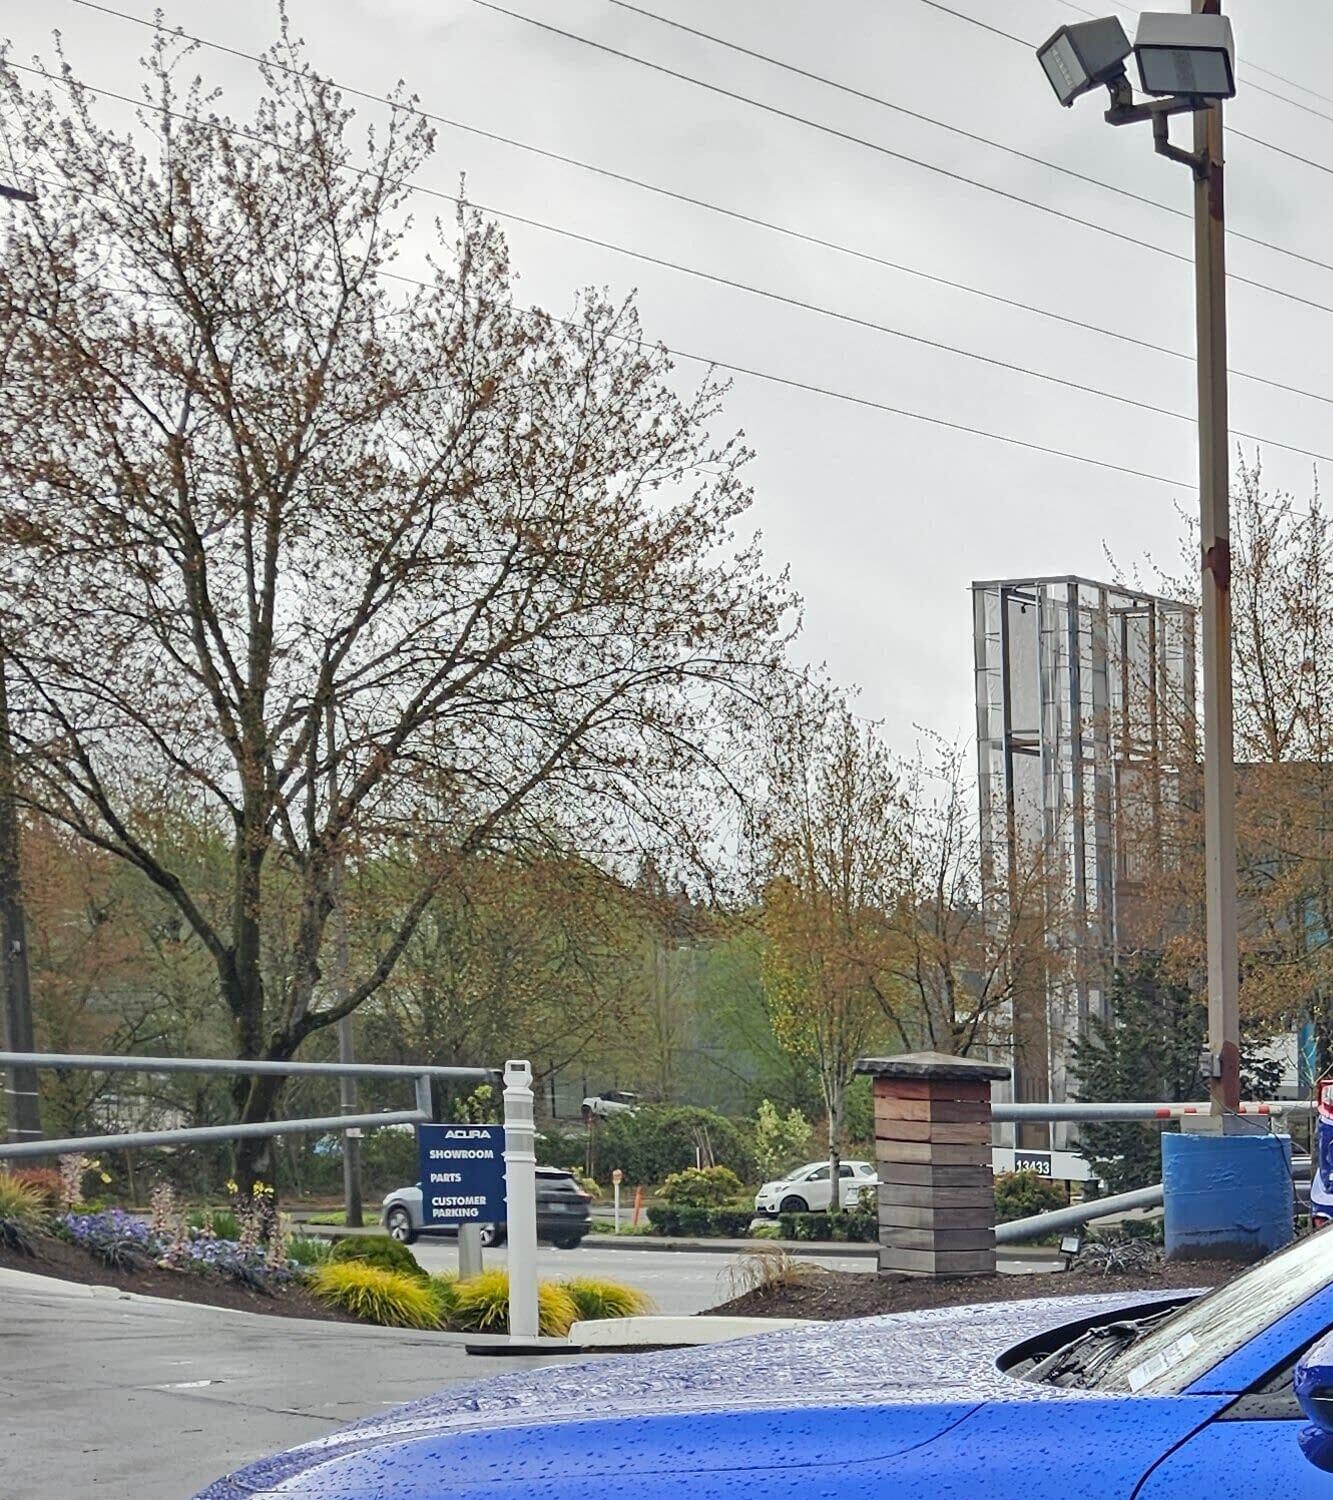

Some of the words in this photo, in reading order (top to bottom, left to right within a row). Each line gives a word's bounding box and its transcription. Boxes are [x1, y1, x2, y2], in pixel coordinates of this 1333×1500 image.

[445, 1129, 491, 1139] ACURA
[429, 1149, 494, 1159] SHOWROOM
[1016, 1159, 1050, 1174] 13433
[430, 1173, 462, 1183] PARTS
[431, 1196, 487, 1206] CUSTOMER
[432, 1208, 479, 1218] PARKING
